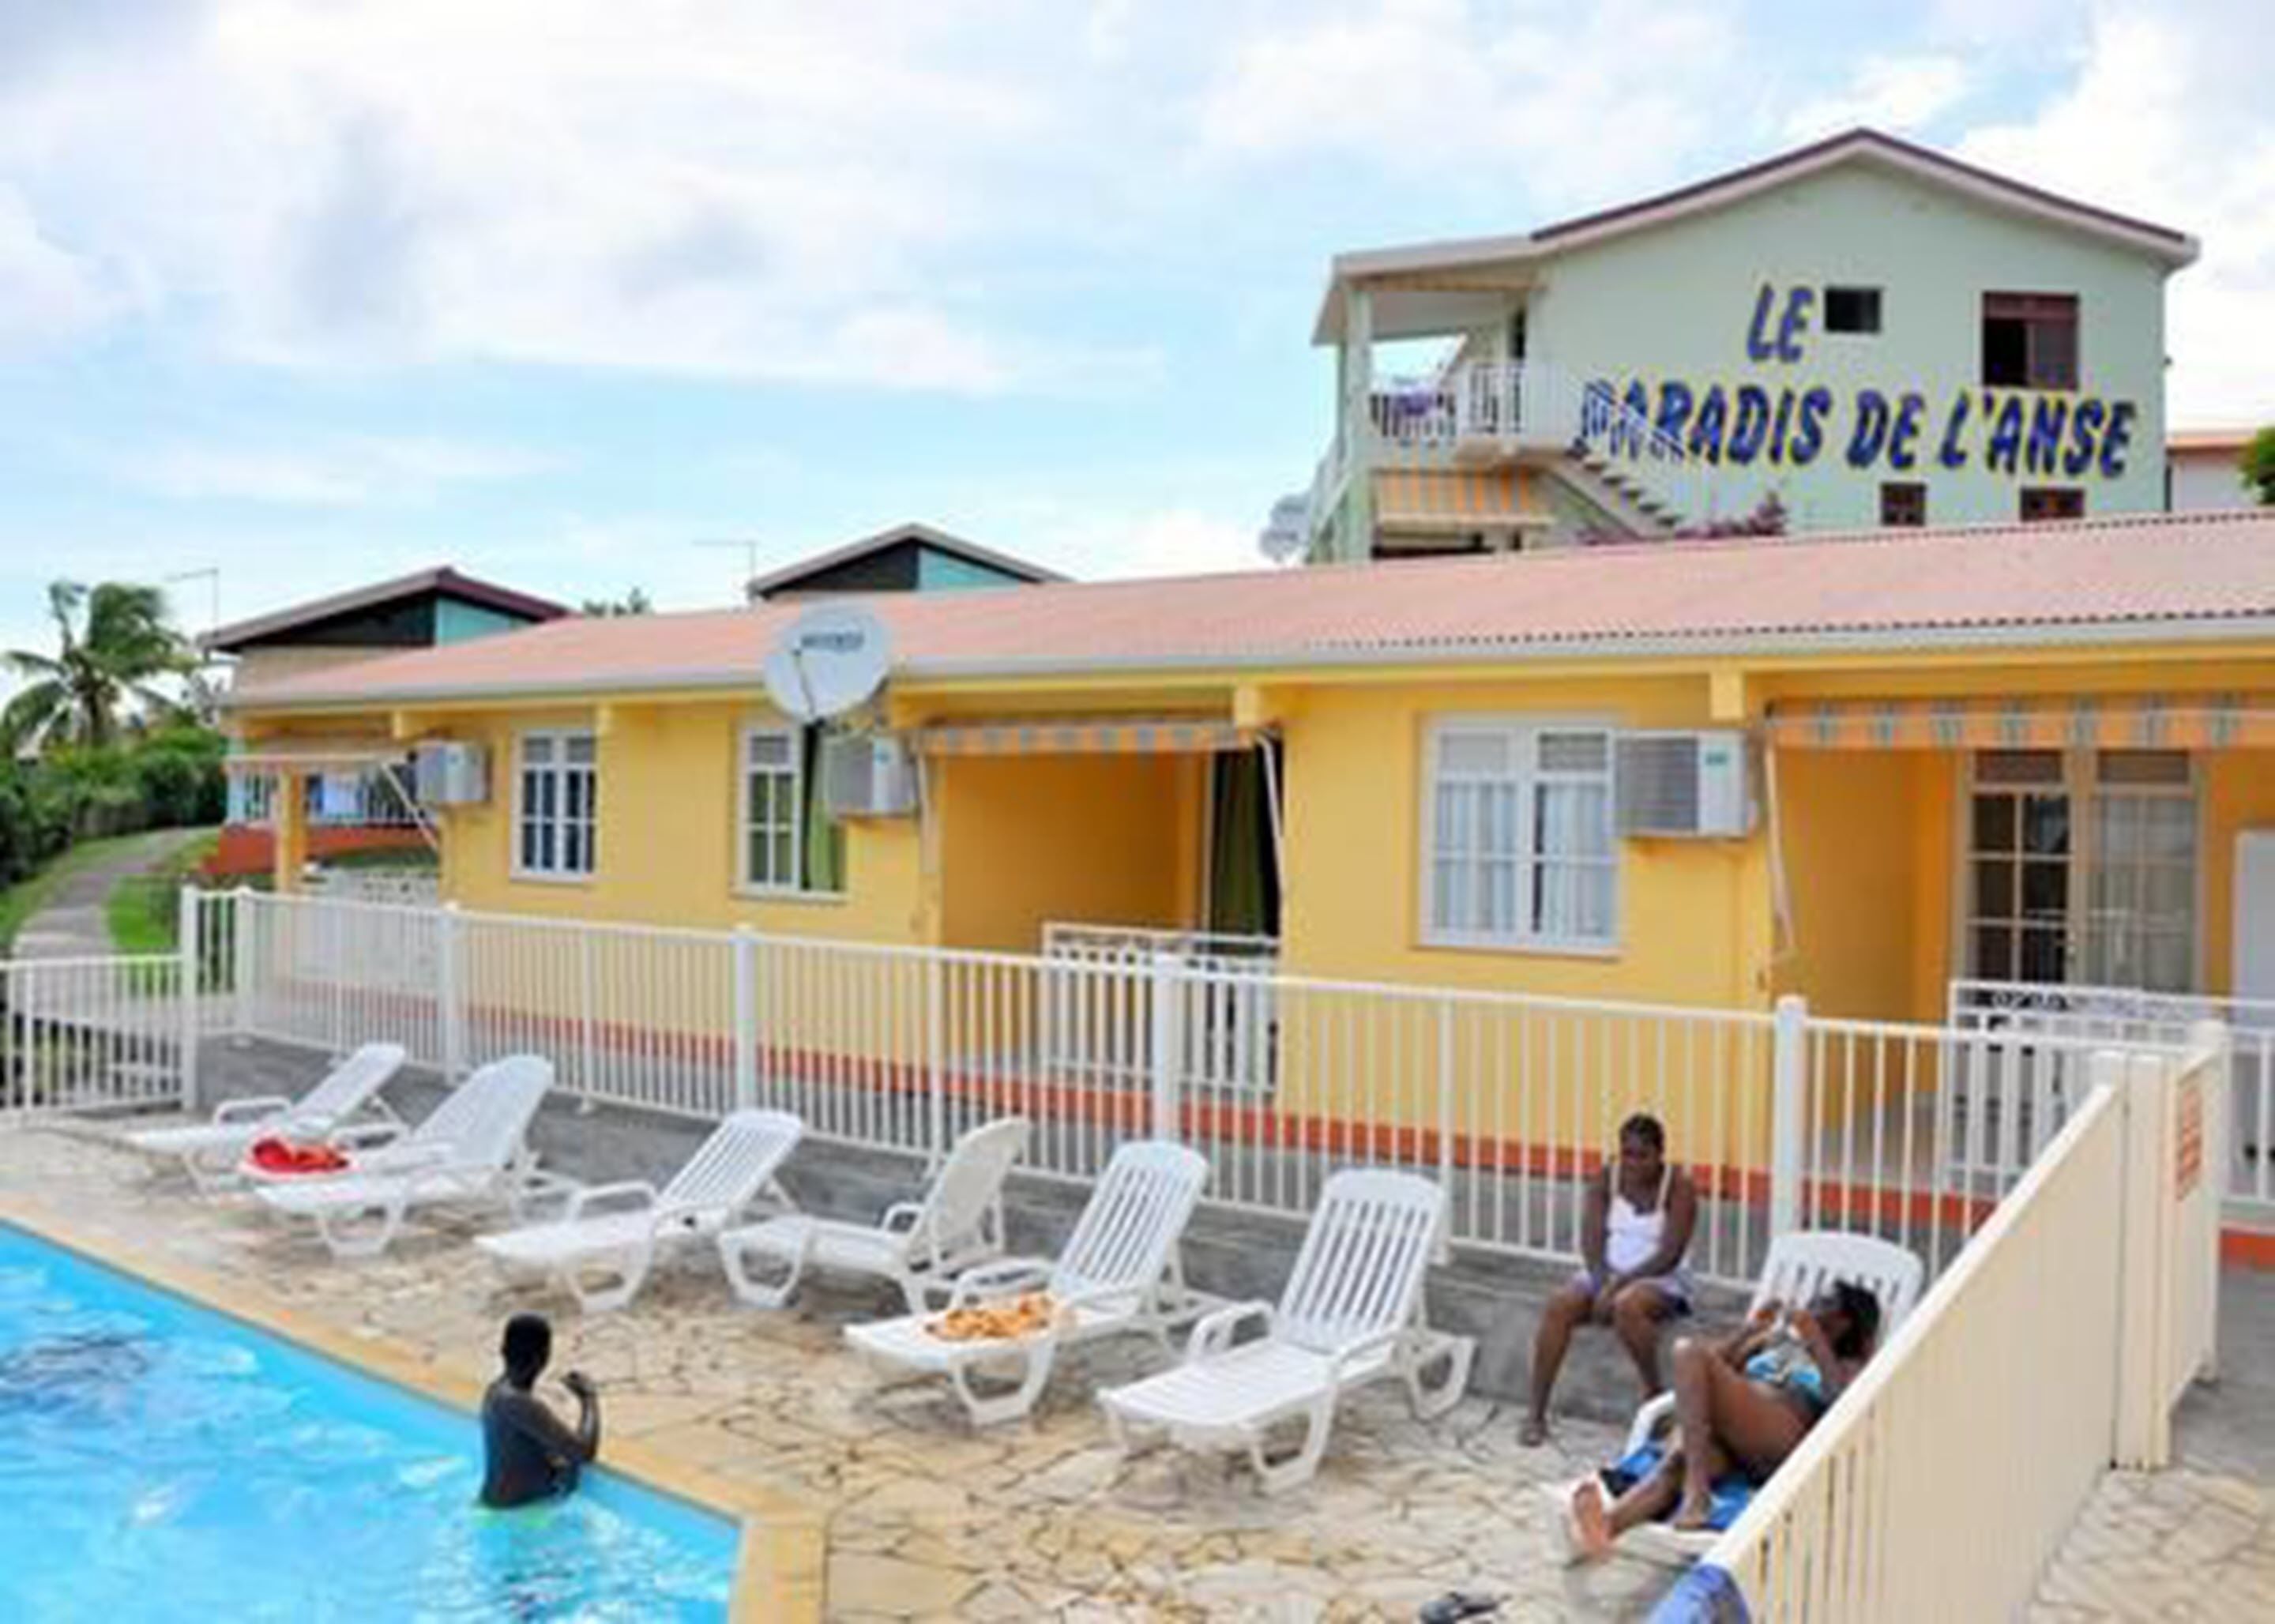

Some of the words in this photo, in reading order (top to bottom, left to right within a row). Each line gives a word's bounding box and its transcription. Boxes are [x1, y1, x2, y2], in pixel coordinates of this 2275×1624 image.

[1747, 283, 1814, 363] LE
[1848, 389, 1926, 470] DE
[1938, 392, 2138, 478] L'ANSE
